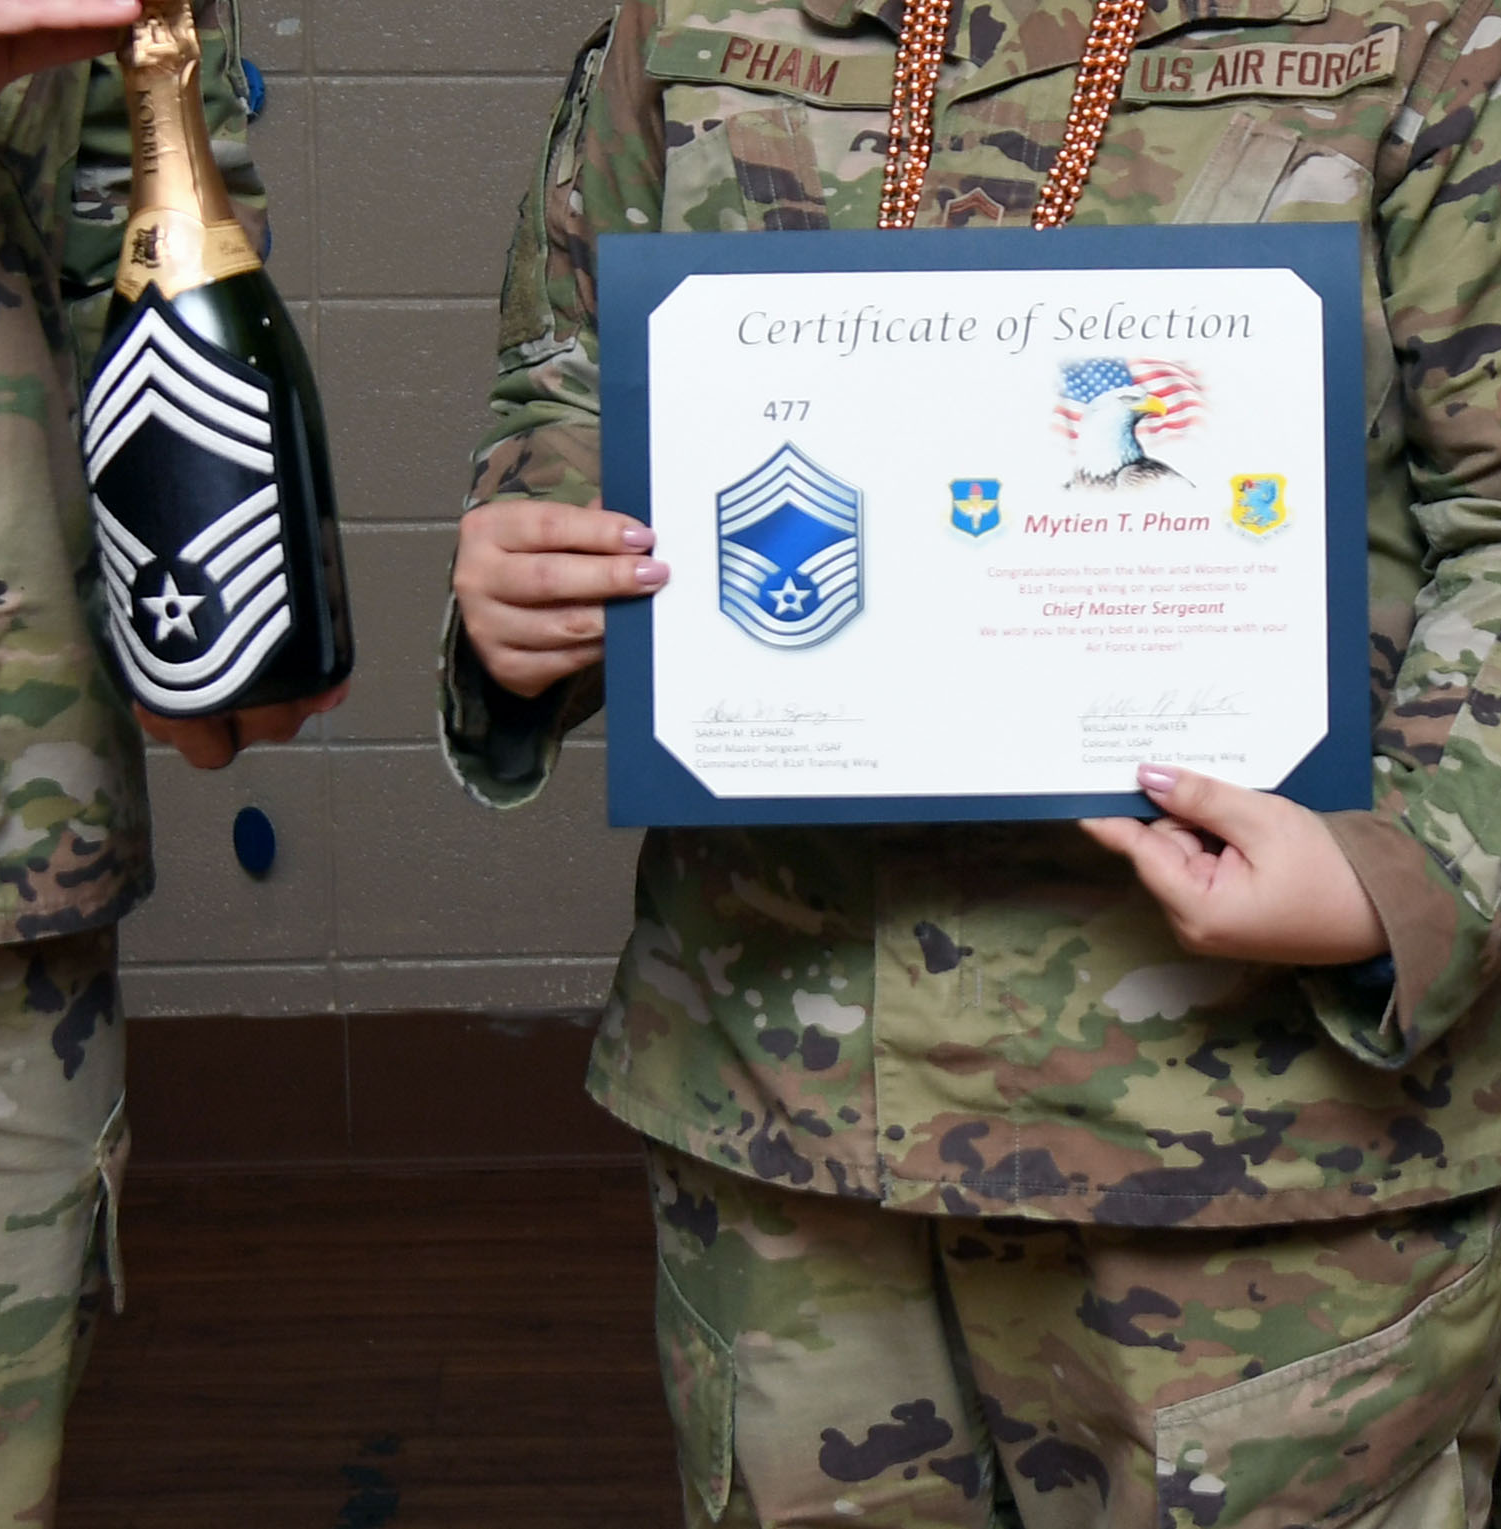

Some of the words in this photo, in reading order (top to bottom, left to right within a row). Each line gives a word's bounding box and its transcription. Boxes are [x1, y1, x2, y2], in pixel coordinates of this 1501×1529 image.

[720, 36, 840, 97] PHAM
[1139, 56, 1195, 93] U.S.
[1206, 49, 1265, 91] AIR
[1276, 37, 1384, 88] FORCE
[738, 306, 977, 357] Certificate
[996, 303, 1046, 354] of
[1054, 302, 1253, 342] Selection
[763, 400, 811, 421] 477
[1024, 513, 1109, 538] Mytien
[1118, 513, 1134, 532] T.
[1143, 512, 1211, 532] Pham
[1042, 602, 1085, 619] Chief
[1088, 602, 1147, 616] Master
[1152, 600, 1226, 618] Sergeant
